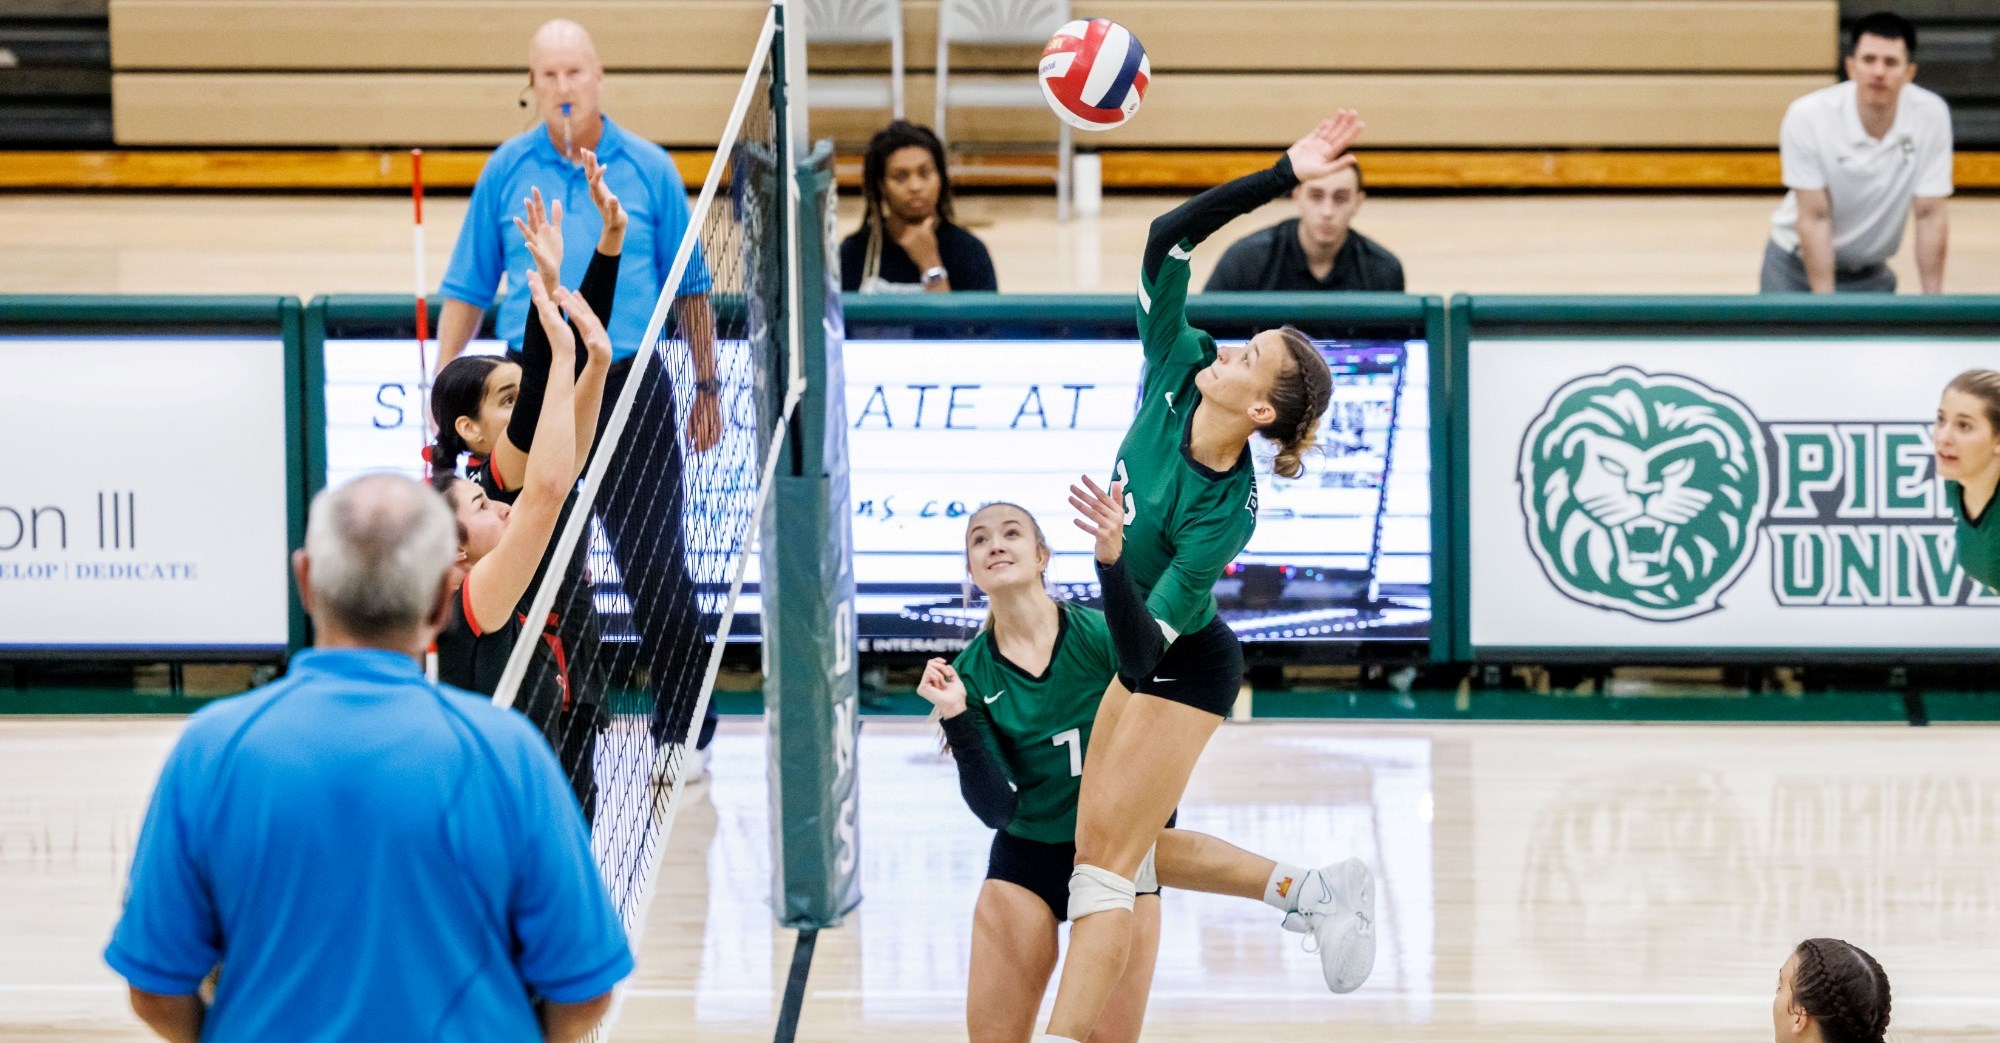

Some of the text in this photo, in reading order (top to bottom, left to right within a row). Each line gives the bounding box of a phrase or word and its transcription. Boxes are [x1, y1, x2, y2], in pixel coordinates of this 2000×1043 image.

[1009, 385, 1096, 430] AT
[1769, 423, 1957, 519] PIE
[75, 562, 198, 580] DEDICATE
[1765, 525, 2000, 607] UNIV
[1051, 727, 1083, 777] 7
